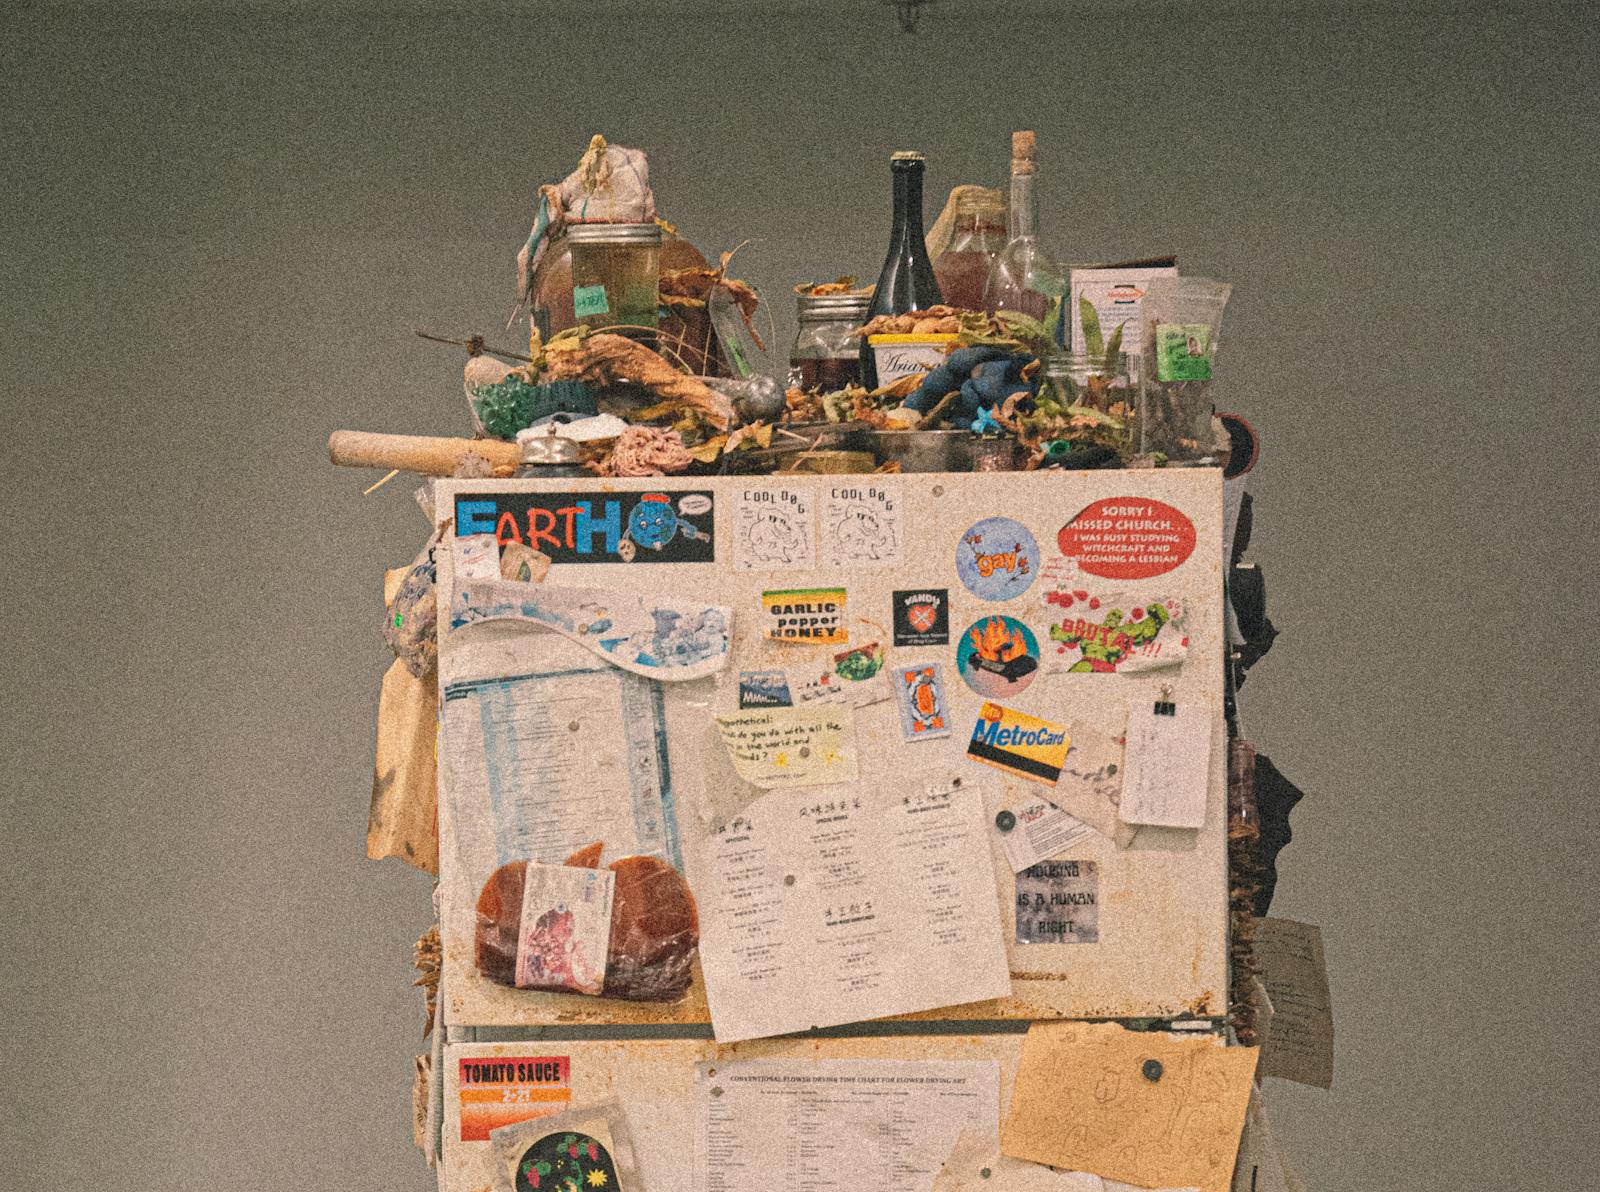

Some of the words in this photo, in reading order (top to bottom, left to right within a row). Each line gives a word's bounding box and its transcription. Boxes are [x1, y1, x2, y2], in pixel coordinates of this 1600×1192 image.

[743, 490, 777, 504] COOL
[831, 487, 864, 501] COOL
[1102, 506, 1144, 516] SORRY
[1147, 506, 1153, 516] I
[1129, 534, 1180, 542] STUDYING
[1082, 544, 1145, 552] WITCHCRAFT
[1147, 544, 1171, 552] AND
[976, 551, 1017, 577] gay
[1139, 555, 1179, 563] LESBIAN
[904, 593, 940, 609] VANDU
[770, 602, 836, 616] GARLIC
[777, 616, 838, 629] pepper
[770, 627, 837, 638] HONEY
[751, 732, 766, 742] you
[784, 726, 806, 735] with
[970, 718, 1066, 748] MetroCard
[1026, 863, 1079, 878] HOUSING
[1017, 893, 1029, 906] IS
[1050, 893, 1095, 905] HUMAN
[1039, 920, 1075, 933] RIGHT
[464, 1063, 515, 1083] TOMATO
[518, 1062, 561, 1082] SAUCE
